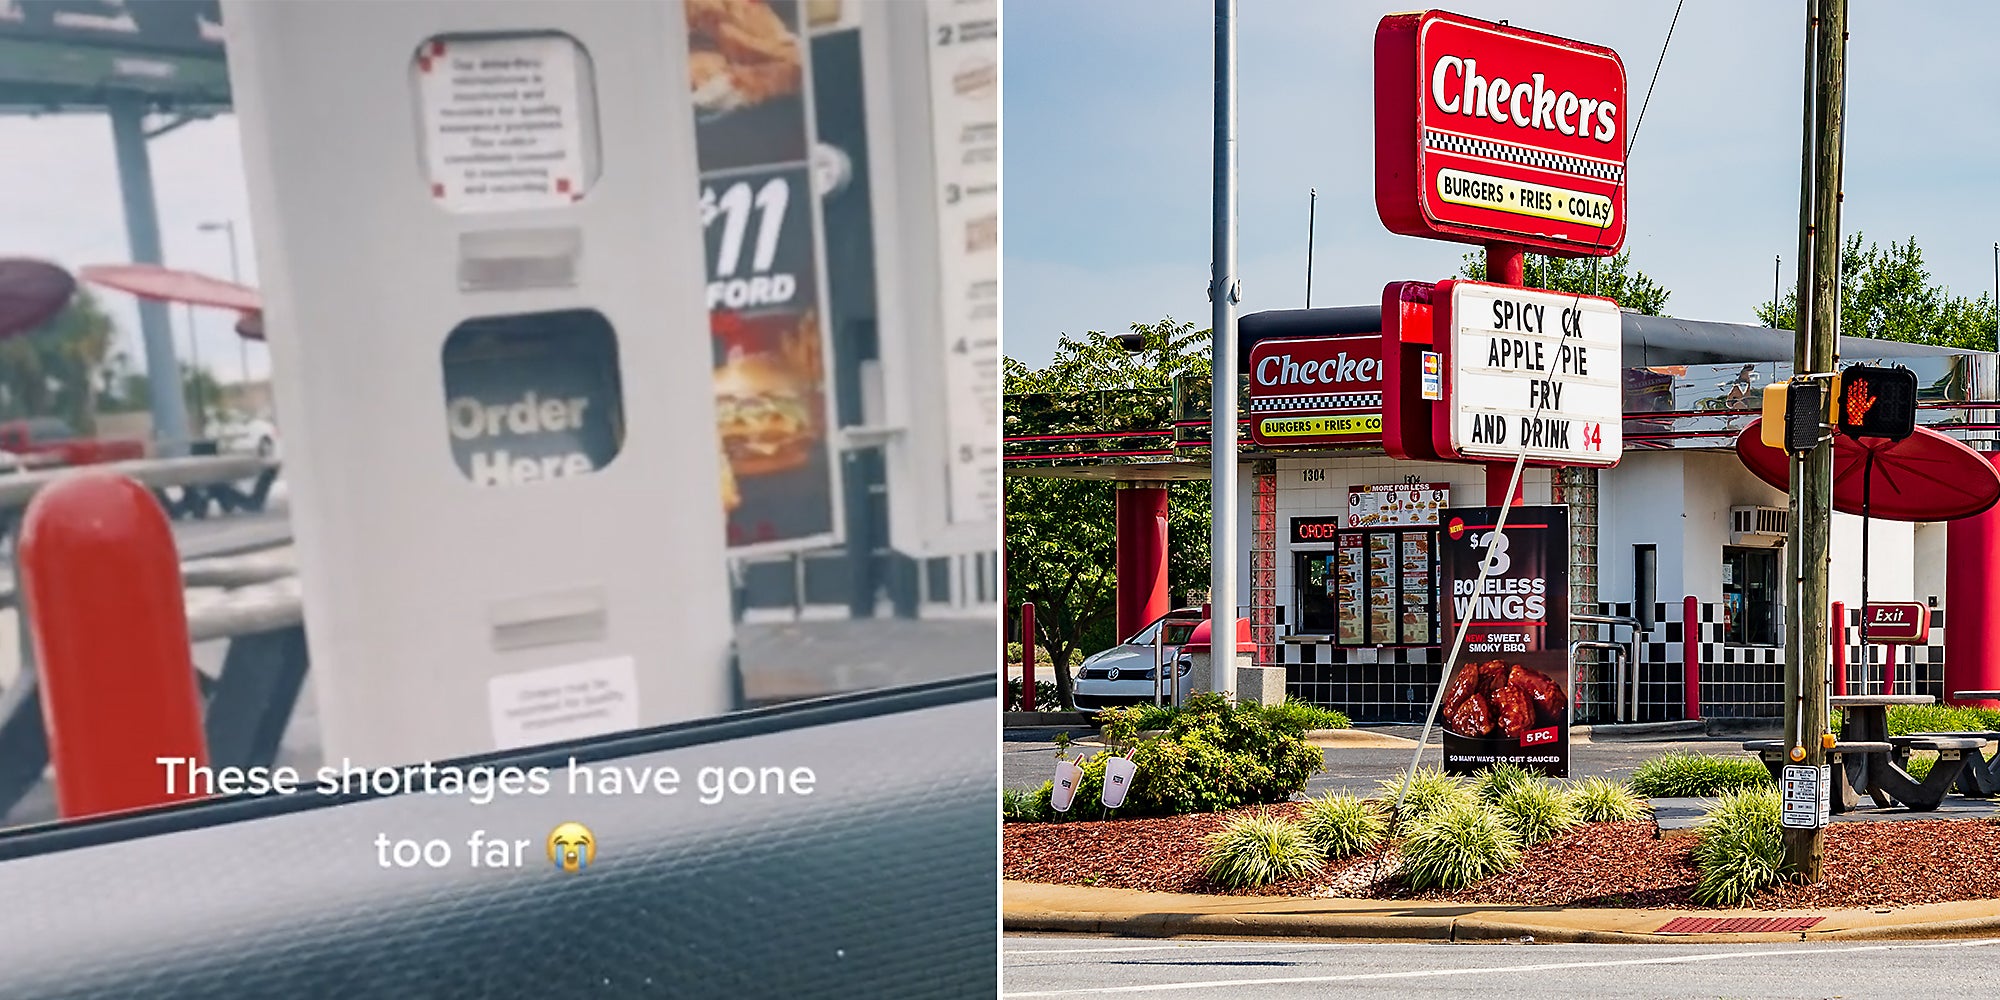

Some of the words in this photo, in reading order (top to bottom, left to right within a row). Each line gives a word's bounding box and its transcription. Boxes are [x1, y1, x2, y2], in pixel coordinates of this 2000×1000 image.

[938, 26, 953, 45] 2
[1432, 55, 1617, 143] Checkers
[946, 183, 961, 204] 3
[1444, 176, 1504, 203] BURGERS
[1520, 189, 1552, 211] FRIES
[1569, 197, 1608, 221] COLAS
[1493, 300, 1545, 334] SPICY
[1562, 308, 1582, 339] CK
[952, 338, 968, 353] 4
[1488, 338, 1545, 371] APPLE
[1563, 345, 1588, 376] PIE
[1530, 380, 1563, 411] FRY
[449, 390, 590, 441] Order
[1265, 421, 1312, 433] BURGERS
[1325, 420, 1352, 431] FRIES
[1472, 414, 1506, 445] AND
[1522, 418, 1570, 450] DRINK
[1584, 422, 1602, 452] $4
[960, 446, 973, 462] 5
[471, 450, 595, 487] Here
[1303, 469, 1325, 482] 1304
[1470, 532, 1511, 576] $3
[1454, 595, 1546, 620] WINGS
[1875, 608, 1904, 621] Exit
[1469, 644, 1501, 653] SMOKY
[1504, 644, 1526, 653] BBQ
[1488, 634, 1521, 643] SWEET
[1524, 634, 1531, 643] &
[1527, 733, 1533, 743] 5
[1535, 732, 1553, 741] PC.
